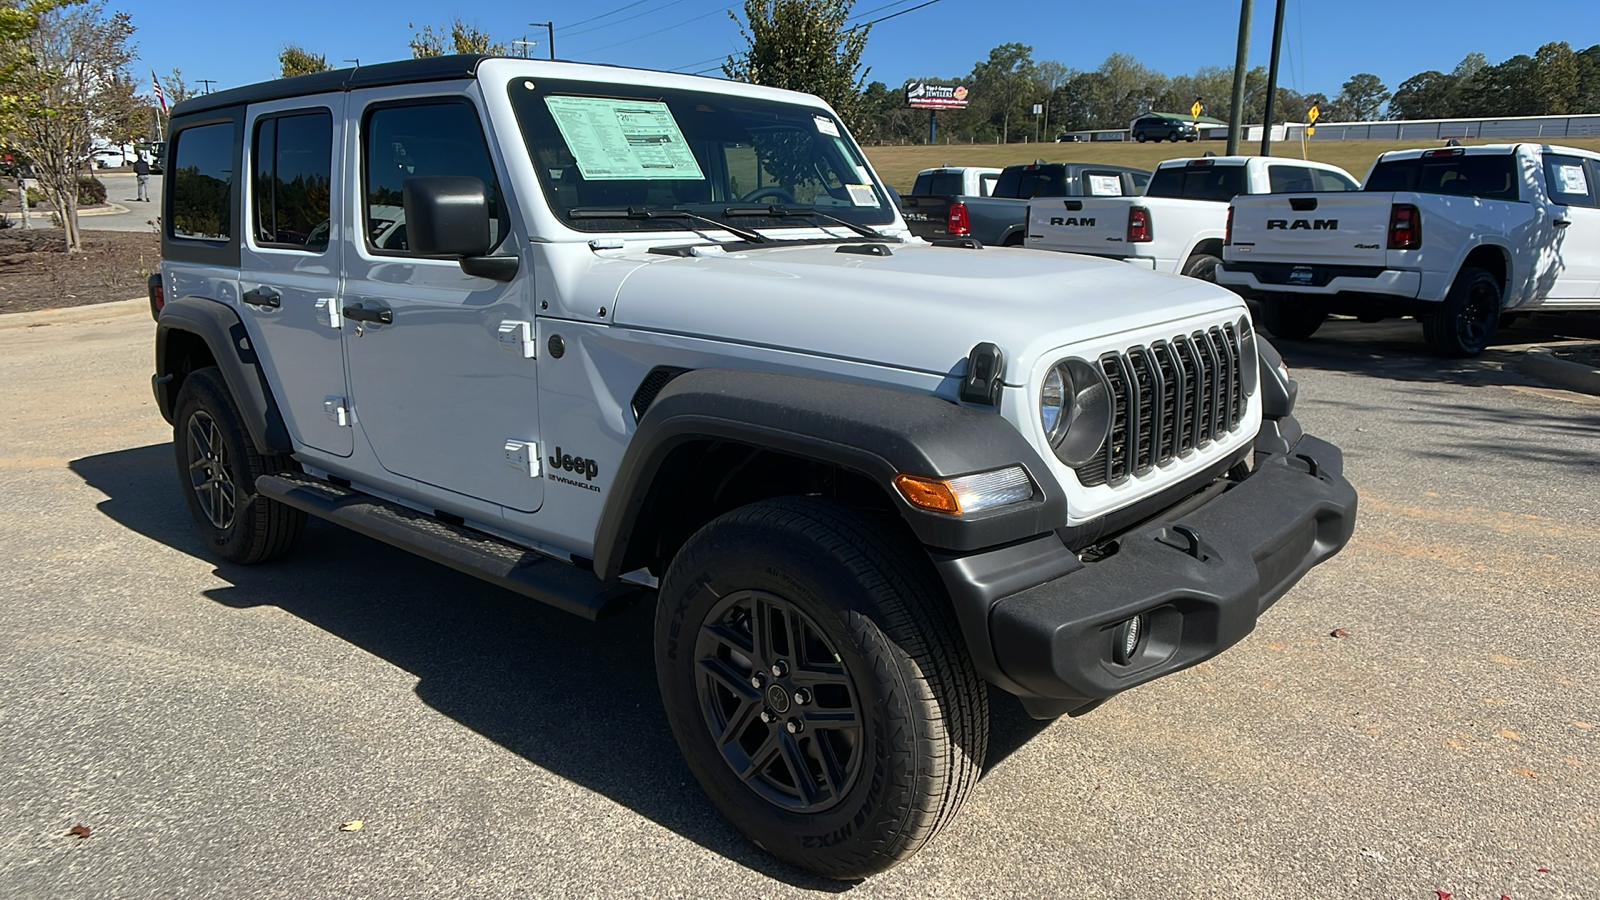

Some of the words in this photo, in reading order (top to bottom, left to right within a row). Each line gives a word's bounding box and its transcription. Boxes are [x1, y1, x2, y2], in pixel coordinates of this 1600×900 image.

[1050, 217, 1096, 226] RAM
[1266, 219, 1339, 230] RAM
[548, 446, 599, 481] Jeep
[556, 475, 601, 493] WRANGLER
[667, 571, 712, 661] NEXEN
